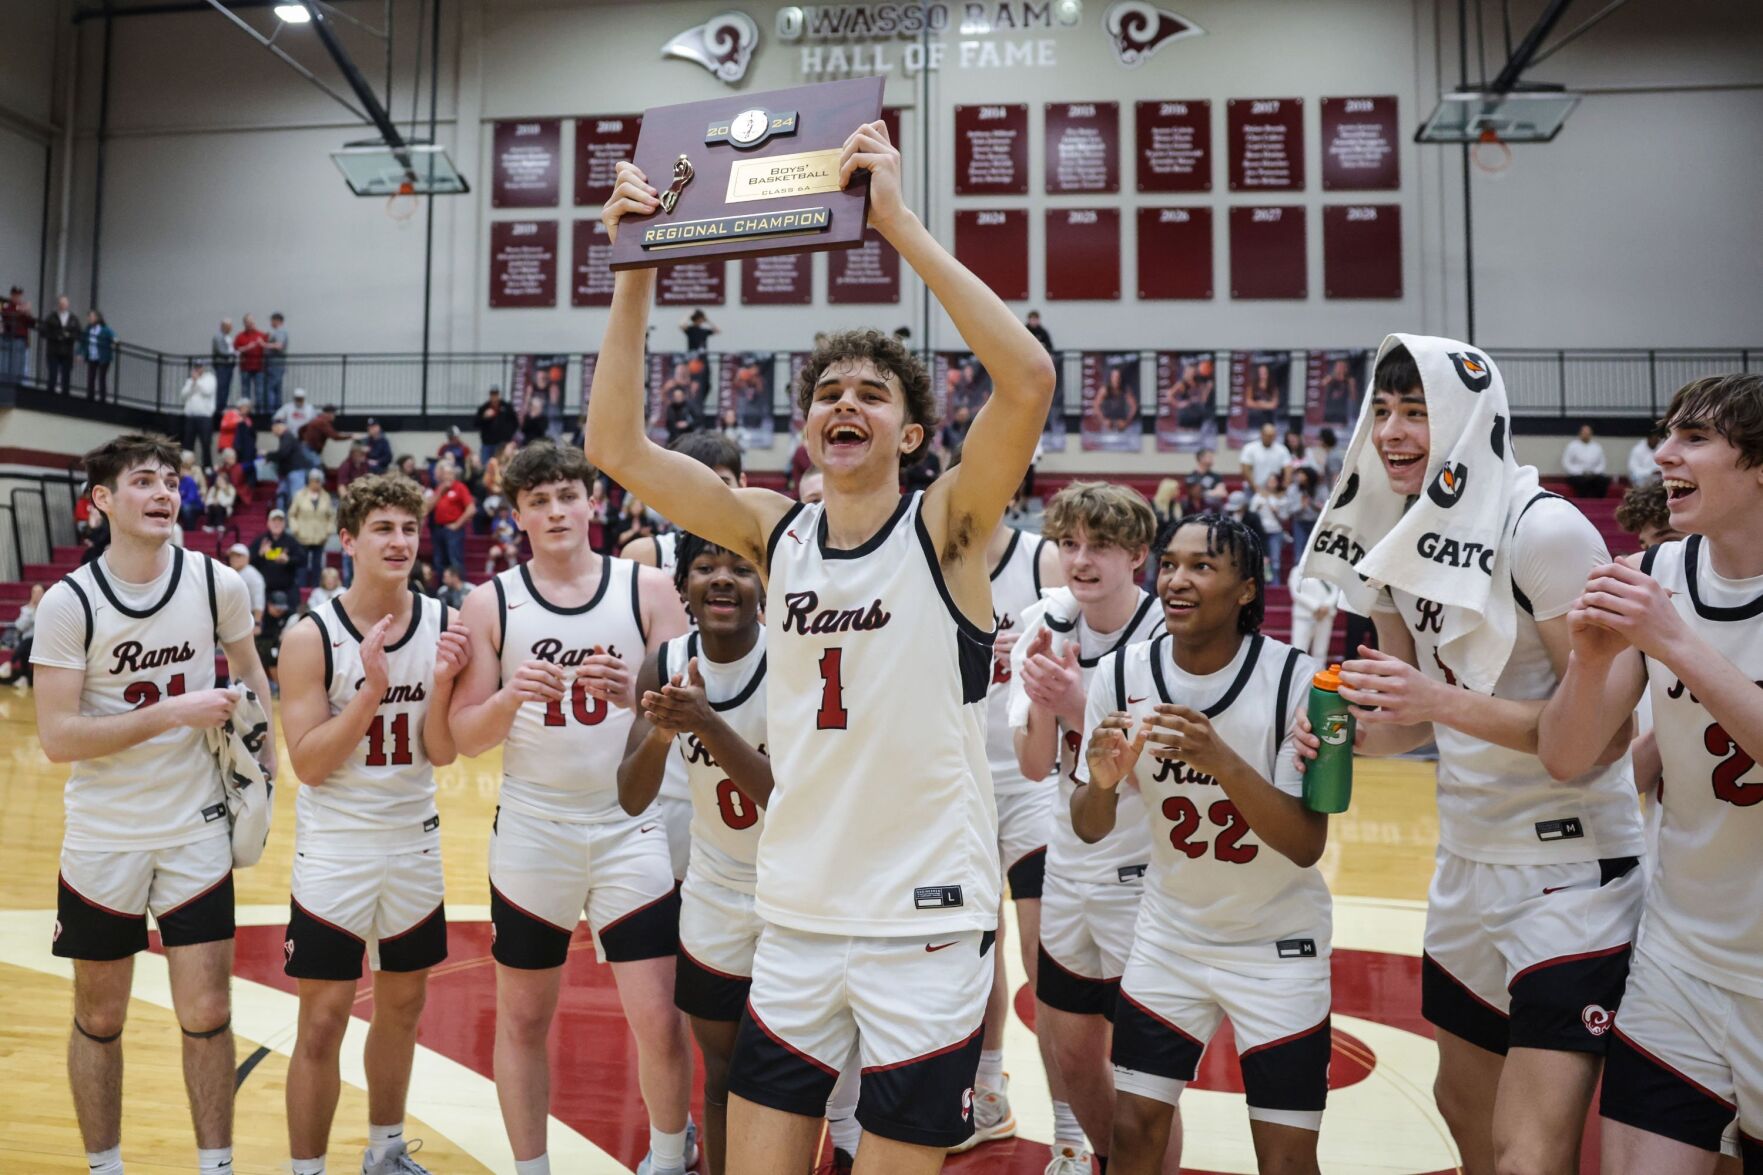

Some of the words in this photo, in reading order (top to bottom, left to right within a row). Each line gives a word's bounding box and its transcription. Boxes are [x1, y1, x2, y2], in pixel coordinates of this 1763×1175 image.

[776, 4, 950, 40] OWASSO
[801, 45, 894, 74] HALL
[905, 42, 947, 72] OF
[959, 40, 1057, 69] FAME
[1251, 101, 1281, 114] 2017
[707, 126, 729, 137] 20
[771, 117, 794, 129] 24
[748, 170, 830, 185] BASKETBALL
[761, 187, 794, 196] CLASS
[645, 223, 728, 242] REGIONAL
[734, 211, 826, 232] CHAMPION
[782, 590, 891, 635] Rams
[109, 640, 195, 674] Rams
[355, 676, 426, 706] ams
[816, 647, 848, 730] 1
[365, 712, 412, 766] 11
[716, 778, 758, 830] 0
[1162, 796, 1259, 864] 22
[1566, 823, 1576, 832] M
[947, 892, 955, 901] L
[1303, 944, 1312, 952] M
